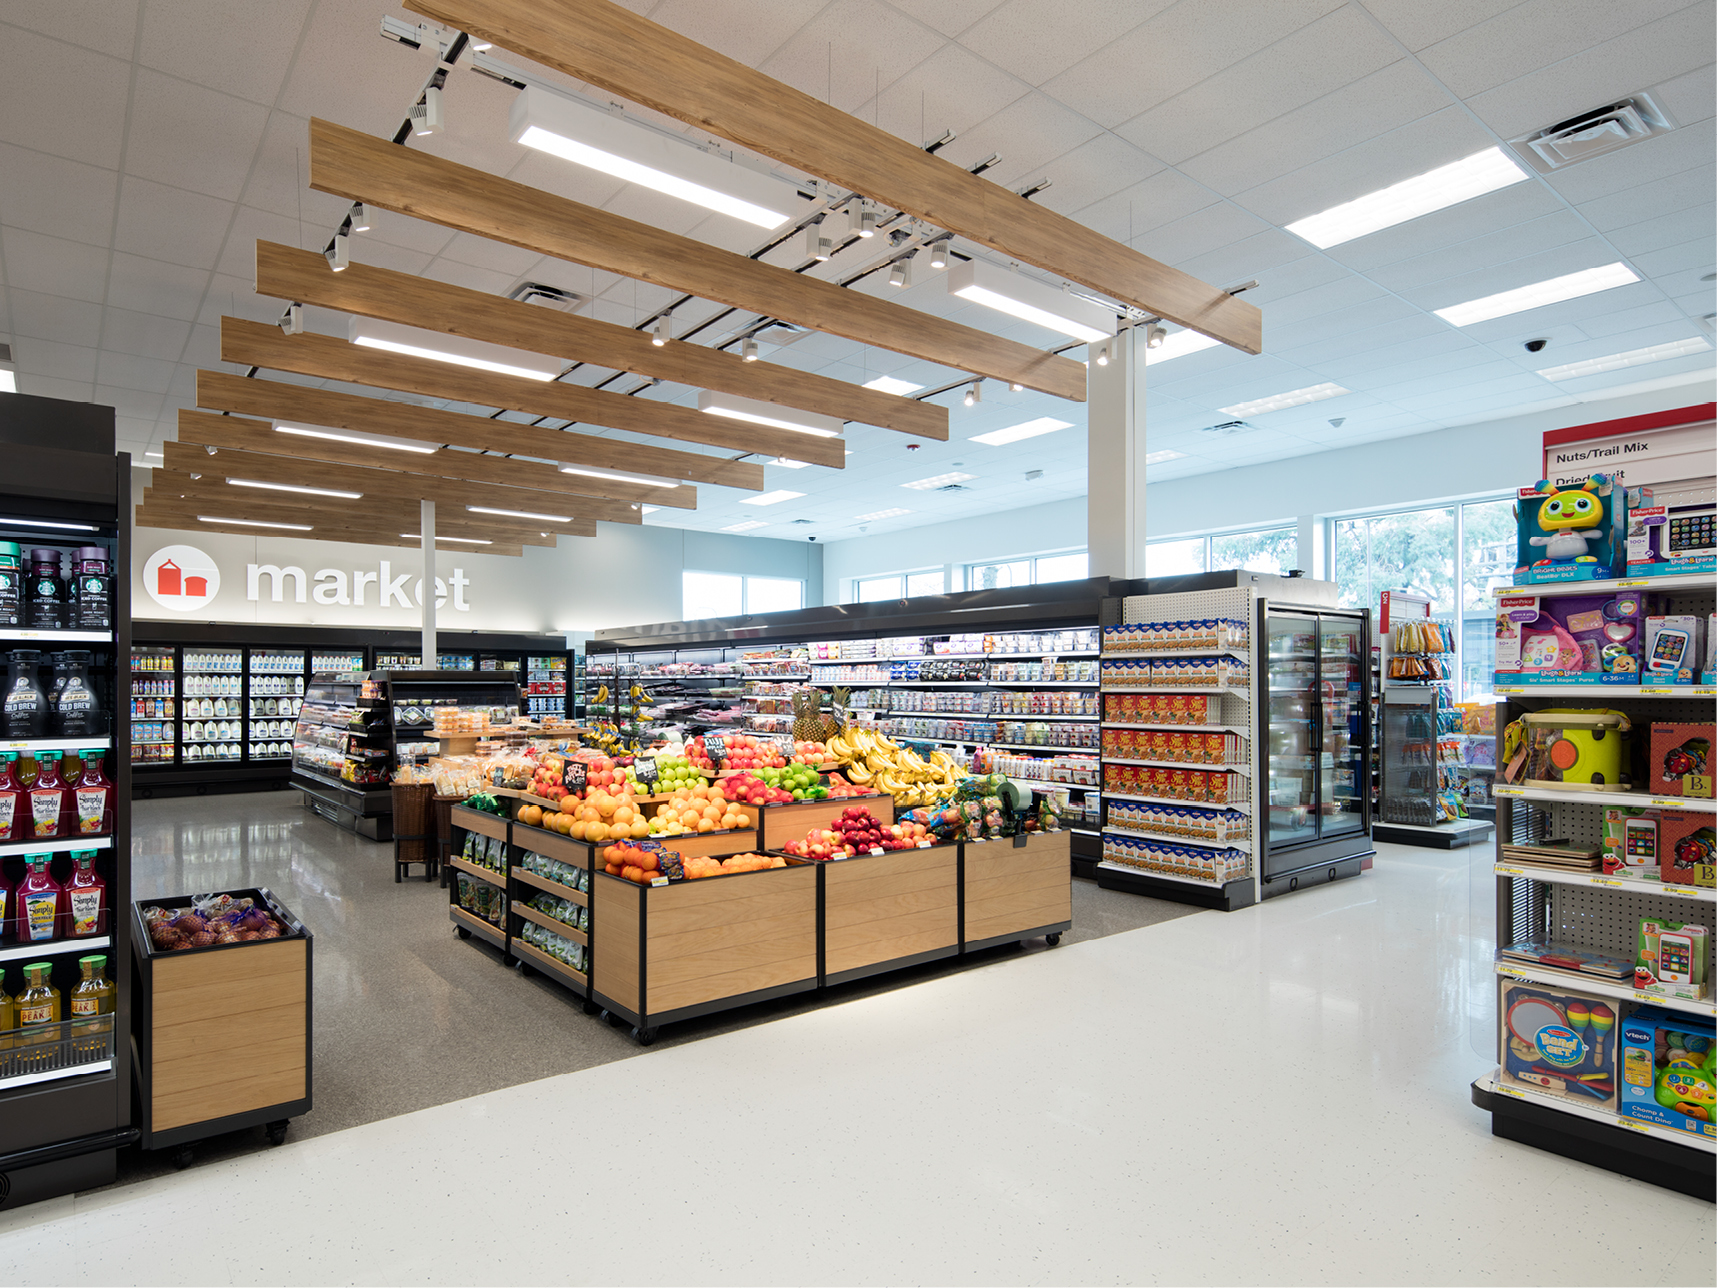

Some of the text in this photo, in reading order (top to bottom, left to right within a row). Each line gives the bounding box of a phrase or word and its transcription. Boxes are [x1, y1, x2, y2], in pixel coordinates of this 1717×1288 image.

[1556, 442, 1649, 464] Nuts/Trail Mix
[246, 559, 471, 612] market
[4, 702, 37, 712] COLD BREW
[58, 702, 91, 711] COLD BREW
[29, 904, 54, 916] Simply
[71, 1004, 89, 1012] PEAK
[22, 1012, 45, 1021] PEAK
[1539, 1032, 1579, 1051] Band
[1546, 1045, 1573, 1057] SET
[1631, 1105, 1658, 1116] Chomp
[1631, 1111, 1672, 1125] Count Dino
